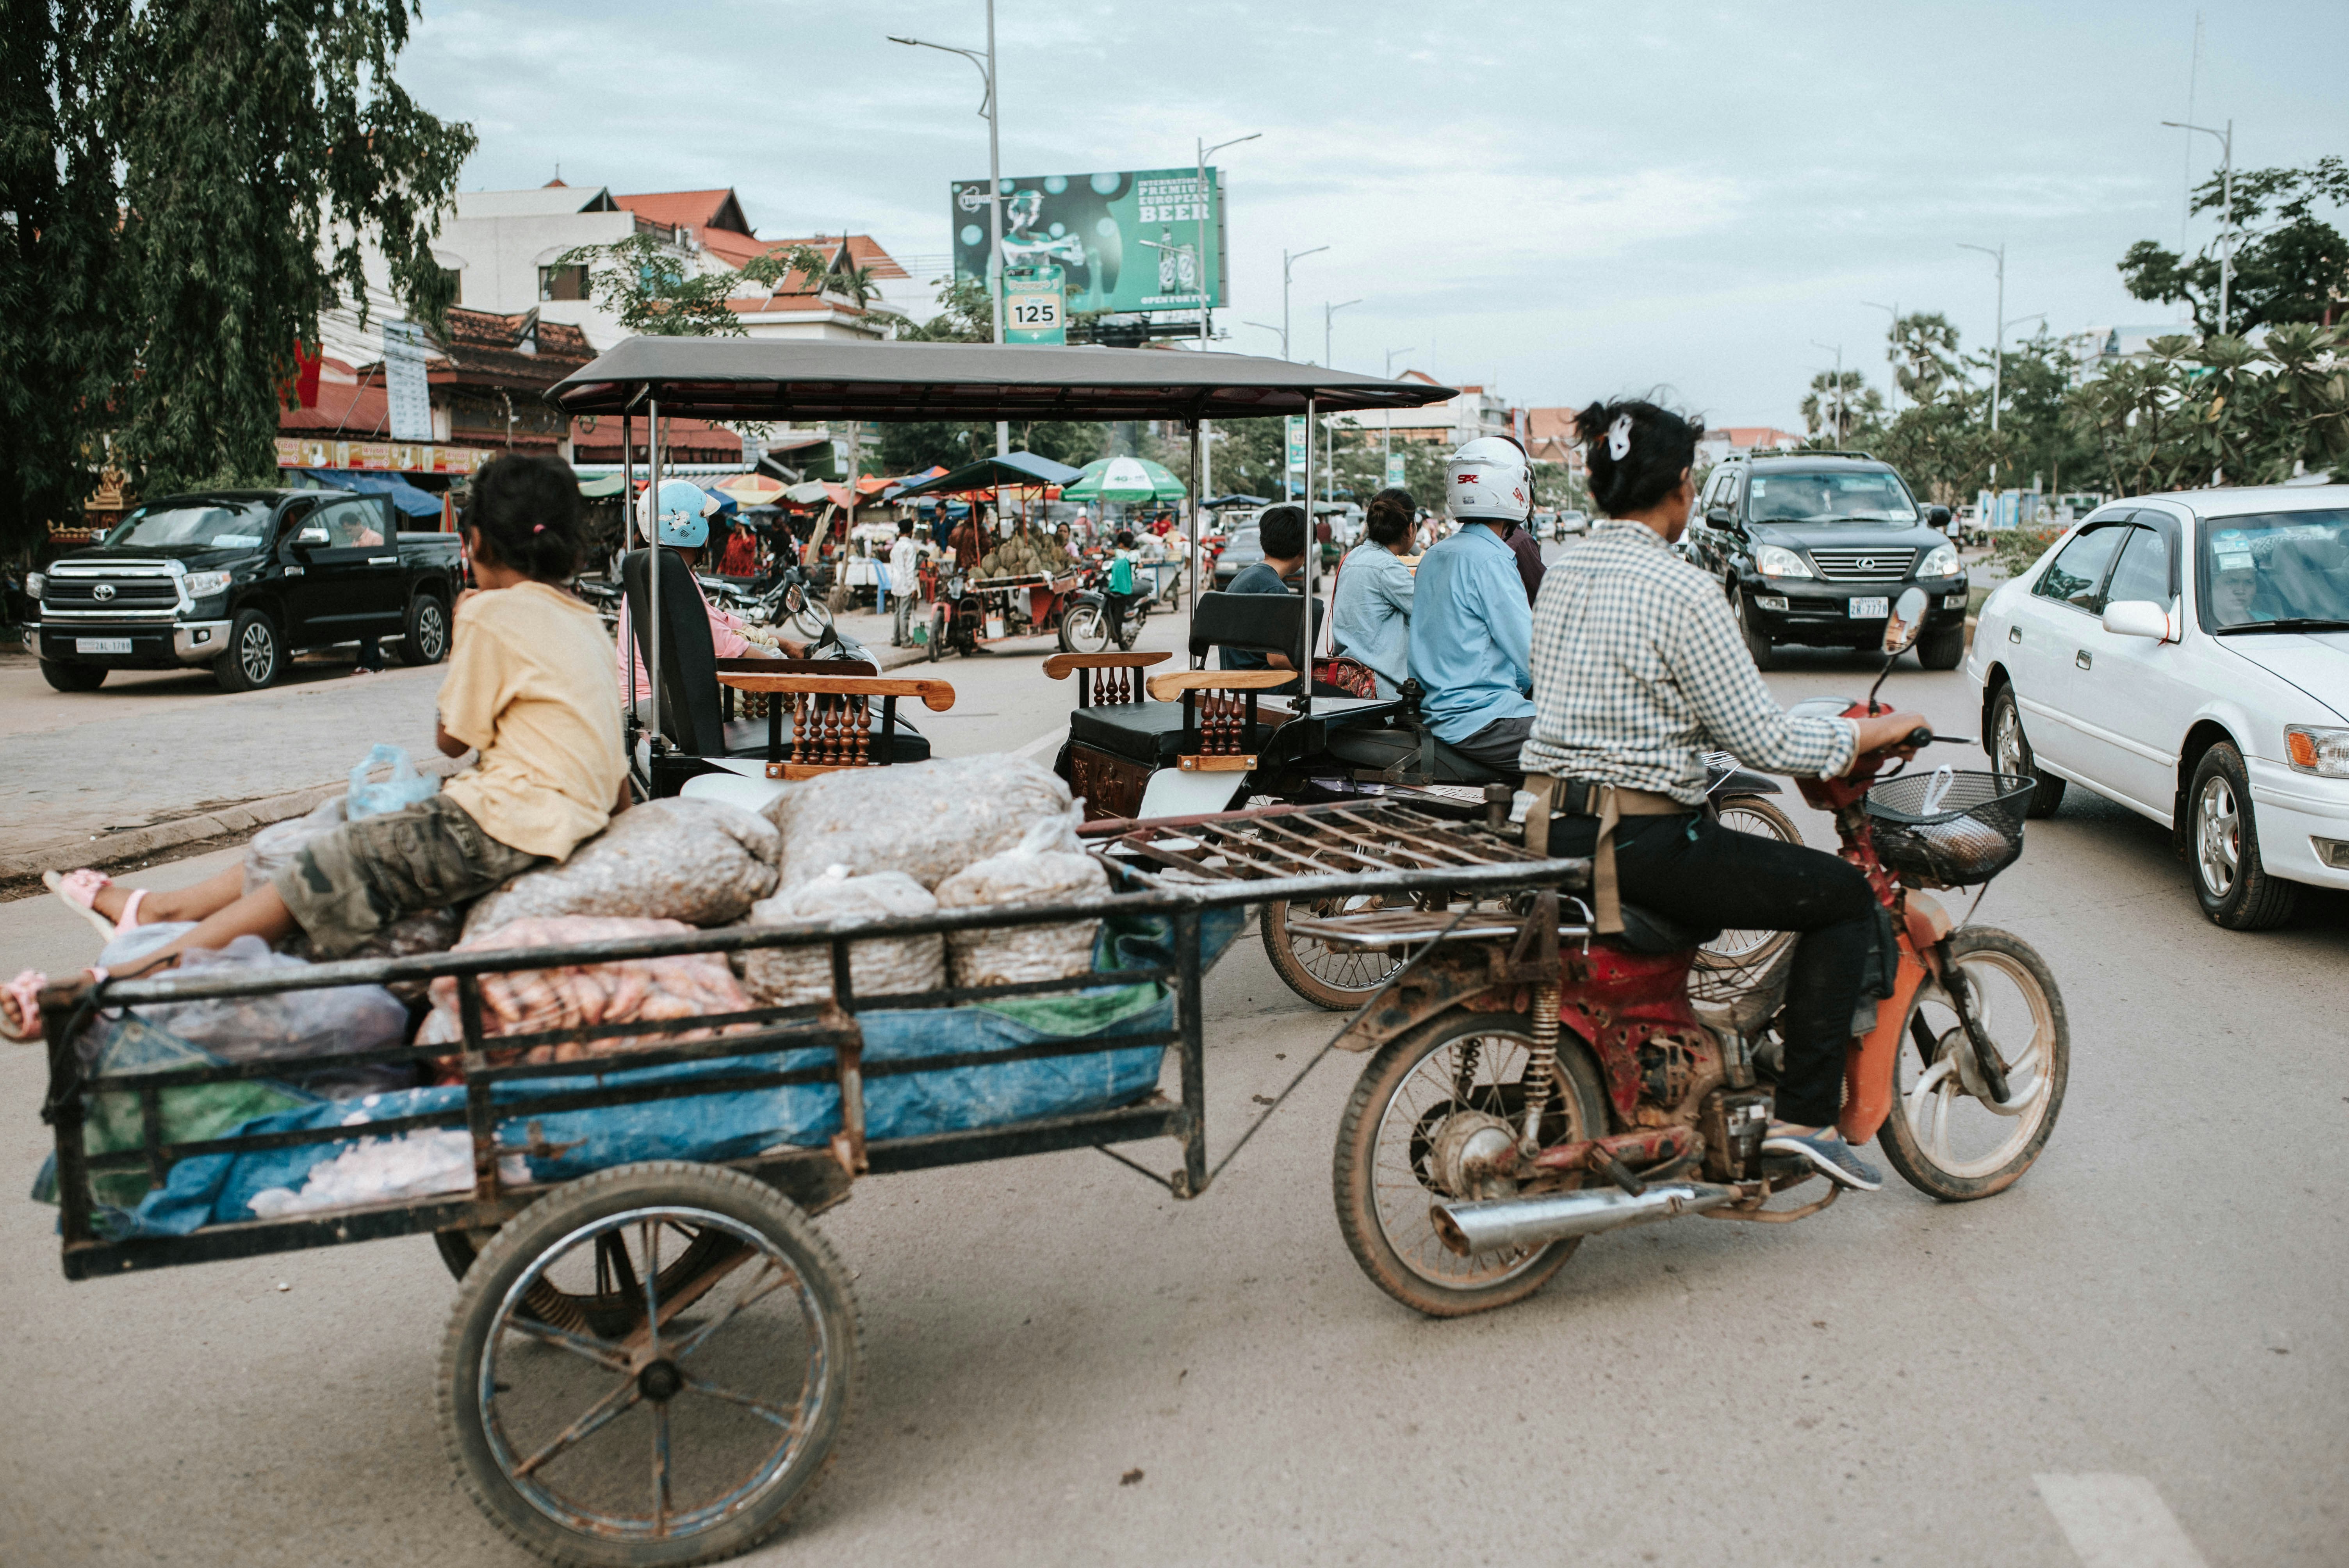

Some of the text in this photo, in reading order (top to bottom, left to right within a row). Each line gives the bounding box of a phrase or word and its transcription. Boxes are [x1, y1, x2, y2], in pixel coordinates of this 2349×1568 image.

[1138, 177, 1210, 187] INTERNATION
[1139, 194, 1209, 205] EUROPEAN
[1139, 203, 1210, 223] BEER
[1016, 305, 1053, 323] 125
